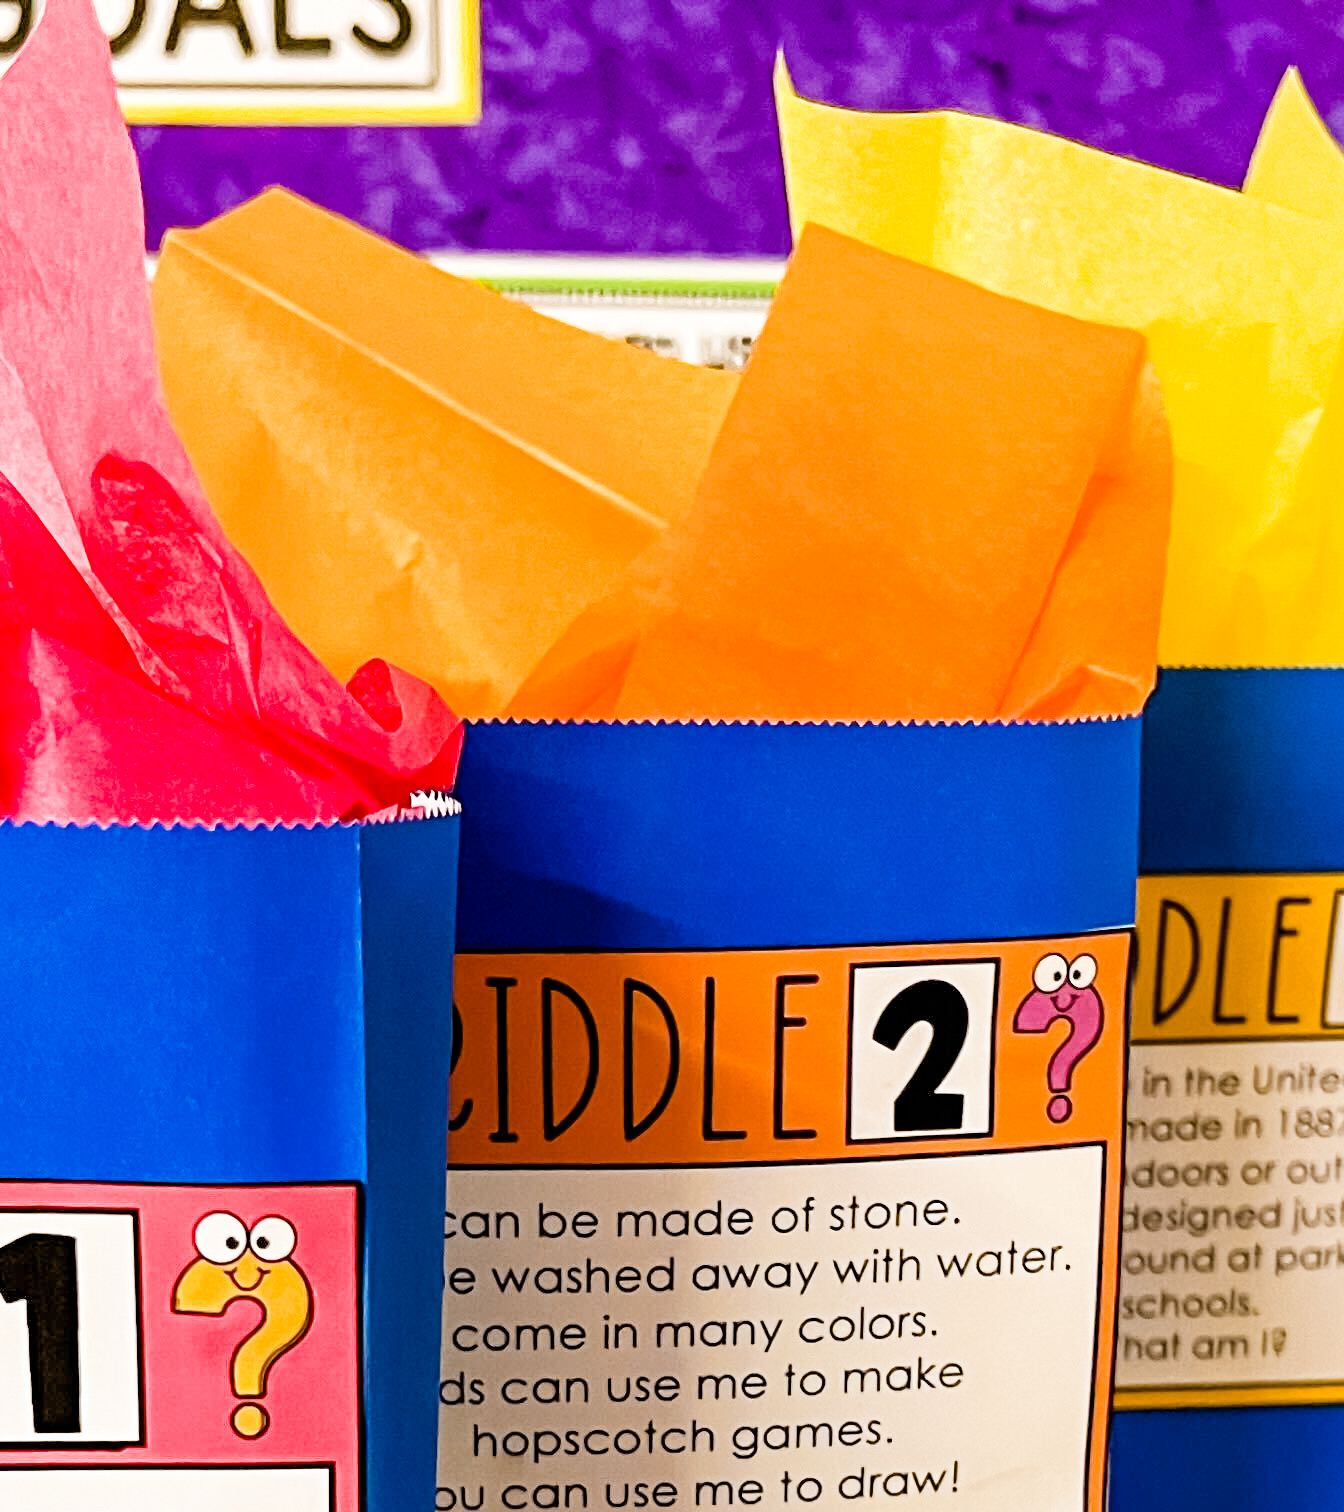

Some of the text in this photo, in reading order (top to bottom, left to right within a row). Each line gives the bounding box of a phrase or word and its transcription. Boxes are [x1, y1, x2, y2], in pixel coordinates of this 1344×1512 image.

[1132, 898, 1311, 1026] DLE
[872, 979, 970, 1132] 2
[1143, 1064, 1171, 1099] in
[1185, 1065, 1240, 1098] the
[1234, 1111, 1263, 1139] in
[1125, 1158, 1229, 1188] doors
[1241, 1159, 1275, 1185] or
[538, 1202, 599, 1239] be
[617, 1199, 754, 1238] made
[771, 1196, 816, 1234] of
[828, 1195, 961, 1232] stone.
[442, 1240, 1071, 1296] e washed away with water.
[1227, 1240, 1262, 1270] at
[1123, 1287, 1260, 1320] schools.
[452, 1305, 938, 1353] come in many colors.
[1192, 1334, 1248, 1359] am
[500, 1377, 589, 1405] can
[607, 1375, 681, 1403] use
[697, 1372, 768, 1401] me
[784, 1363, 827, 1397] to
[843, 1355, 965, 1395] make
[473, 1419, 893, 1465] hopscotch games.
[500, 1483, 588, 1510] can
[605, 1481, 678, 1508] use
[695, 1479, 764, 1507] me
[780, 1470, 823, 1504] to
[838, 1459, 959, 1500] draw!
